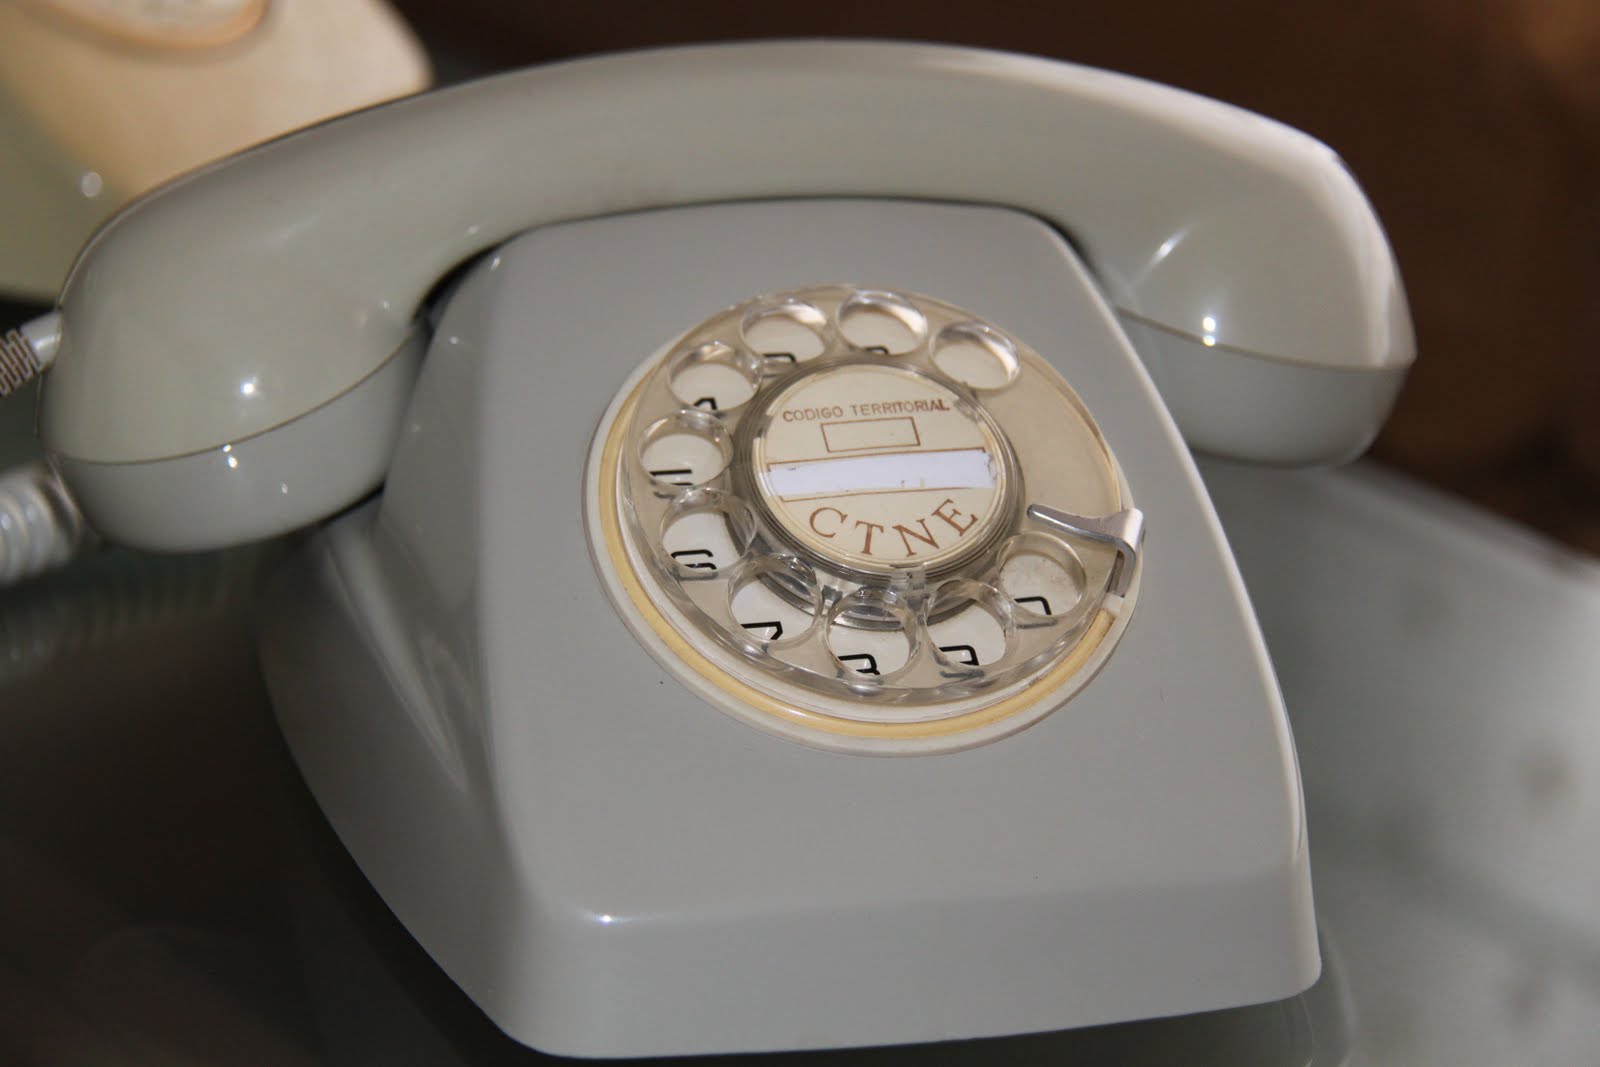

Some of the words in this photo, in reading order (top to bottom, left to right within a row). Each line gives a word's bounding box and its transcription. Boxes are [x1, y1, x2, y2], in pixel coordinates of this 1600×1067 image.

[782, 404, 844, 423] CODIGO
[849, 398, 950, 417] TERRITORIAL
[808, 498, 979, 558] CTNE
